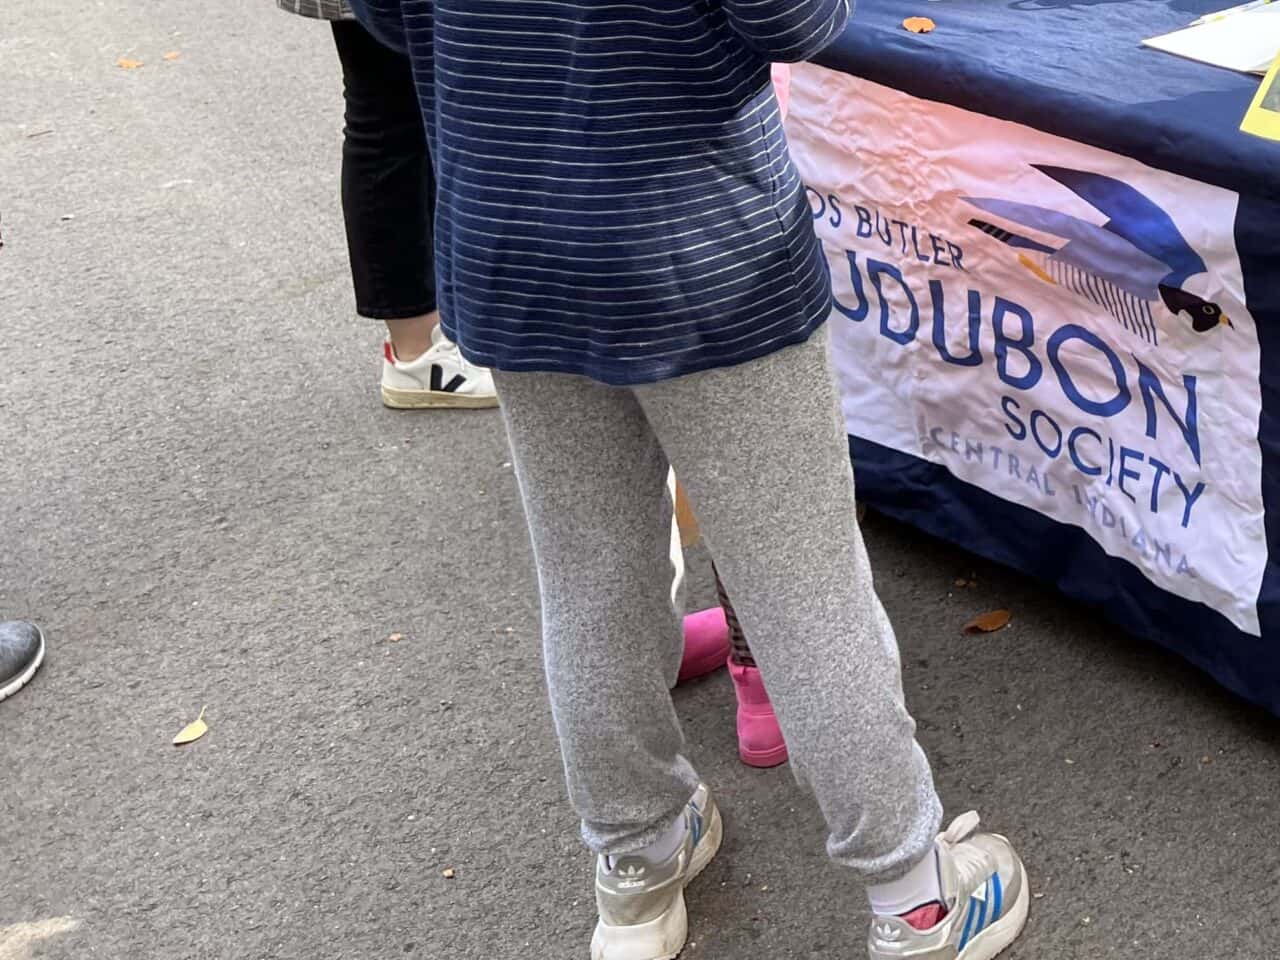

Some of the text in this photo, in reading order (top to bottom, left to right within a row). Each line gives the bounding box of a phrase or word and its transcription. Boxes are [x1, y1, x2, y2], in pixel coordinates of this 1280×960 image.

[806, 185, 968, 274] OS BUTLER
[818, 238, 1201, 469] UDUBON
[930, 427, 1198, 578] CENTRAL INDIANA
[1001, 396, 1206, 528] SOCIETY
